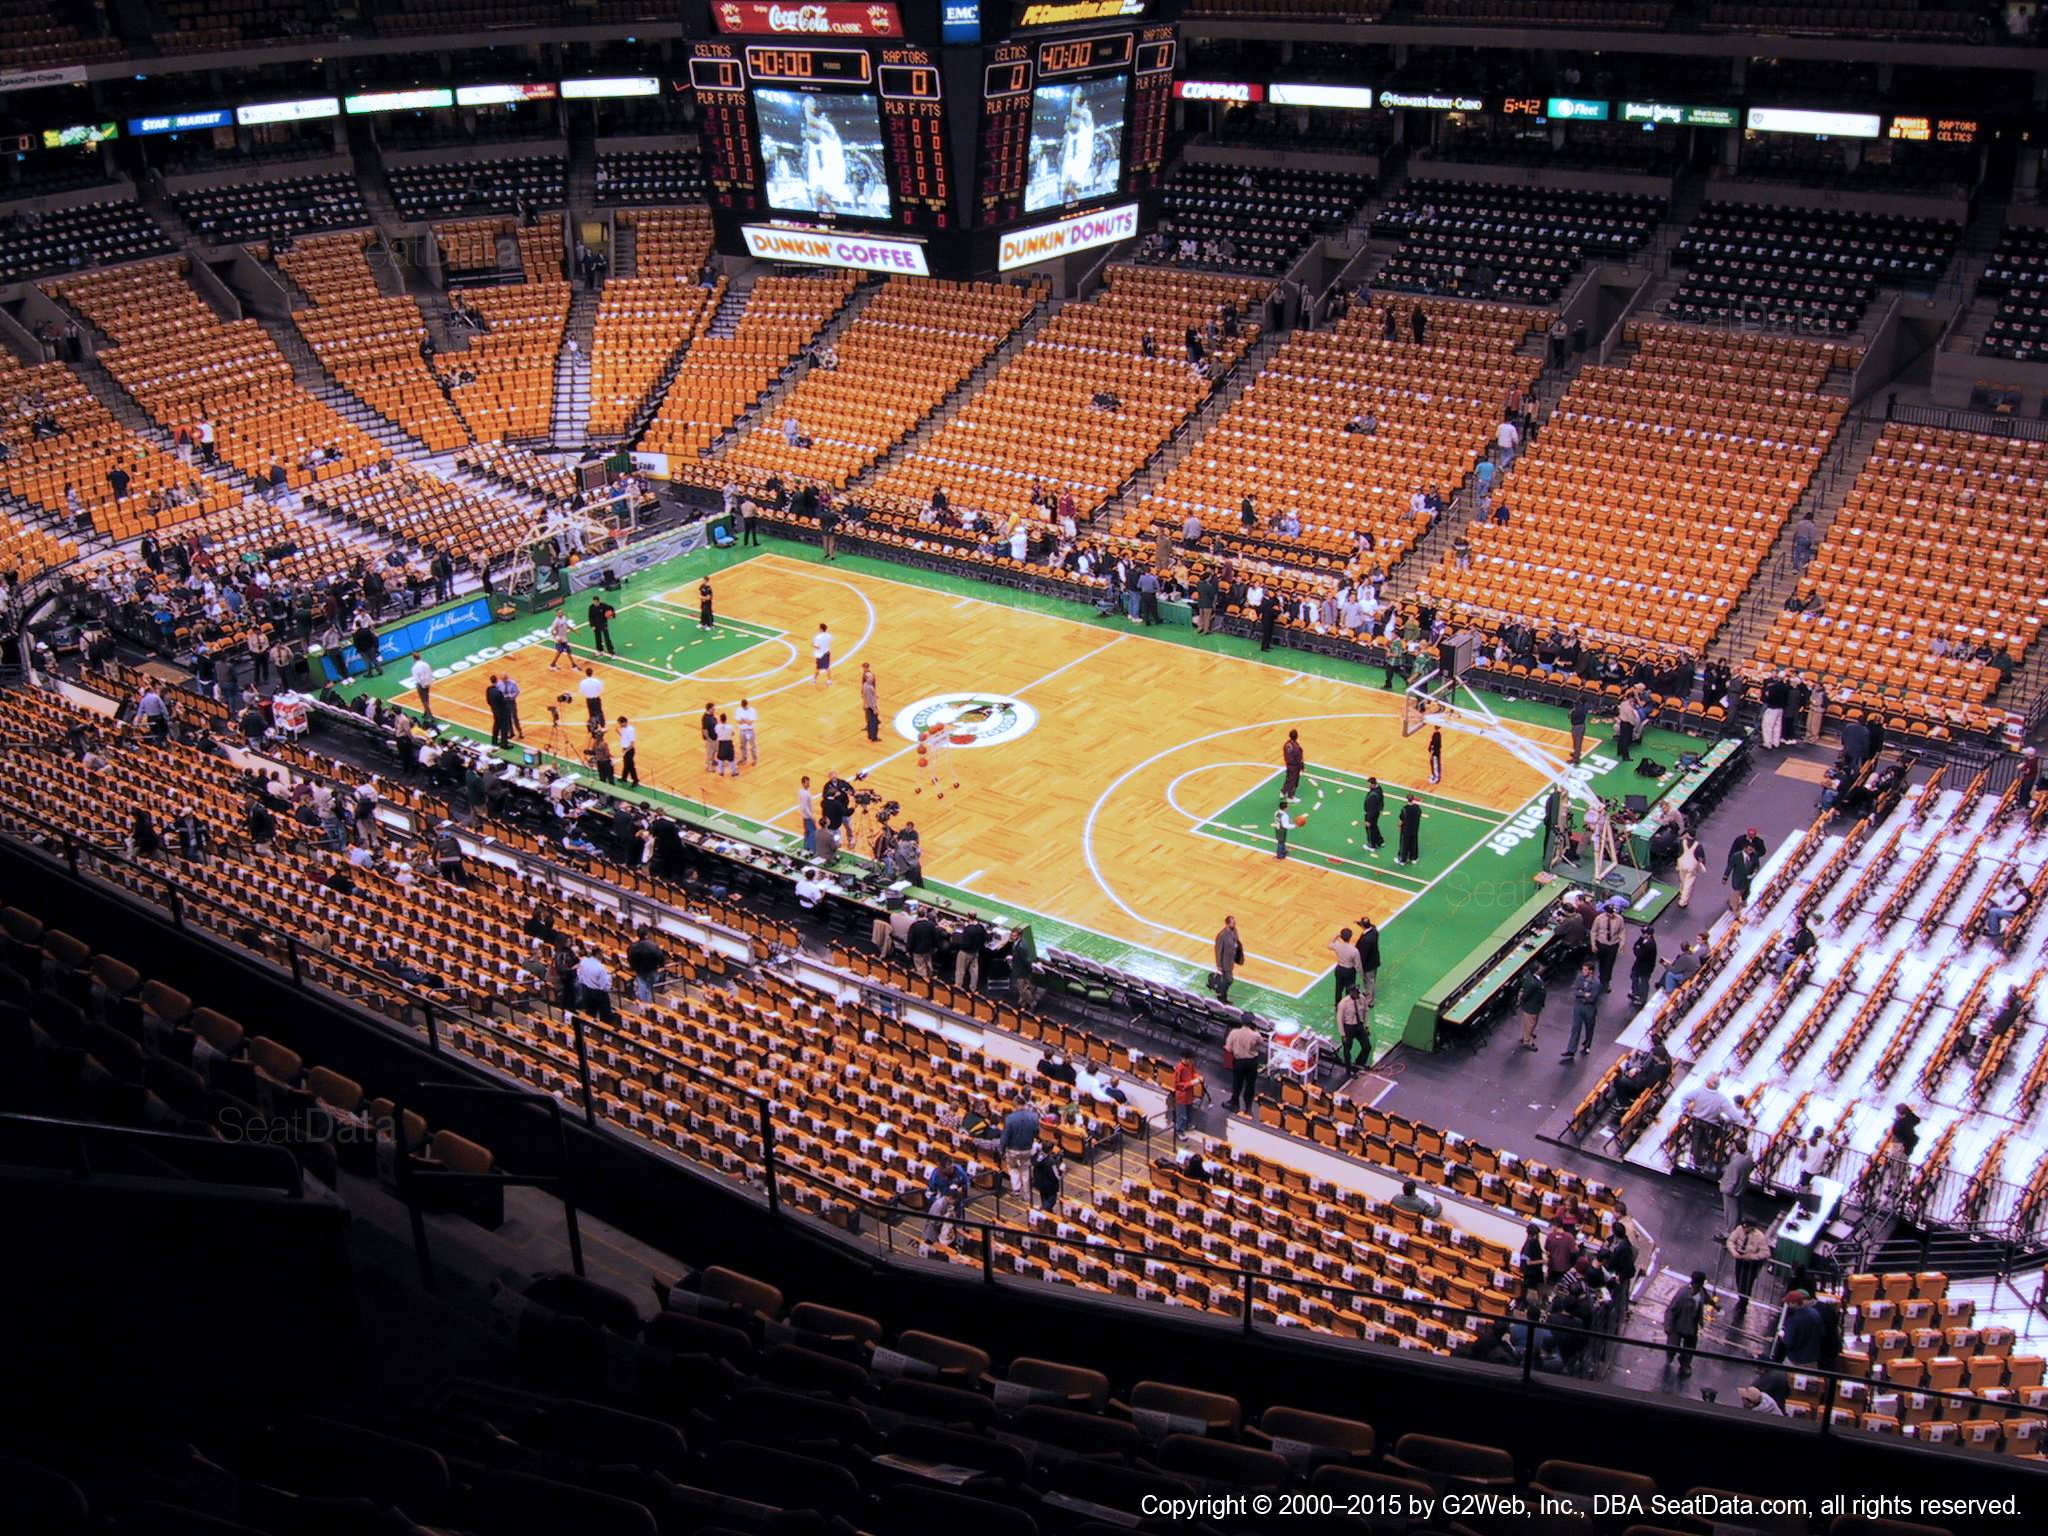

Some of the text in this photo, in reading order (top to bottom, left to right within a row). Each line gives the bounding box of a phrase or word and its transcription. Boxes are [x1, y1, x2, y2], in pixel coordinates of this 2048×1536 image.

[769, 4, 829, 32] Coca-Cola
[694, 44, 732, 57] CELTICS
[883, 50, 928, 64] RAPTORS
[995, 45, 1028, 61] CELTICS
[1042, 42, 1092, 70] 40:00
[1157, 45, 1168, 68] 0
[750, 52, 812, 76] 40:00
[720, 63, 732, 86] 0
[912, 71, 927, 95] 0
[1011, 64, 1024, 90] 0
[727, 93, 746, 106] PTS
[986, 100, 1002, 114] PLR
[1014, 96, 1031, 110] PTS
[1504, 98, 1541, 115] 6:42
[885, 101, 942, 117] PLR F PTS
[1573, 103, 1599, 116] Fleet
[142, 113, 221, 130] STAR MARKET
[1938, 120, 1977, 131] RAPTORS
[1937, 131, 1973, 142] CELTICS
[1003, 212, 1132, 262] DUNKIN' DONUTS
[752, 234, 916, 268] DUNKIN' COFFEE
